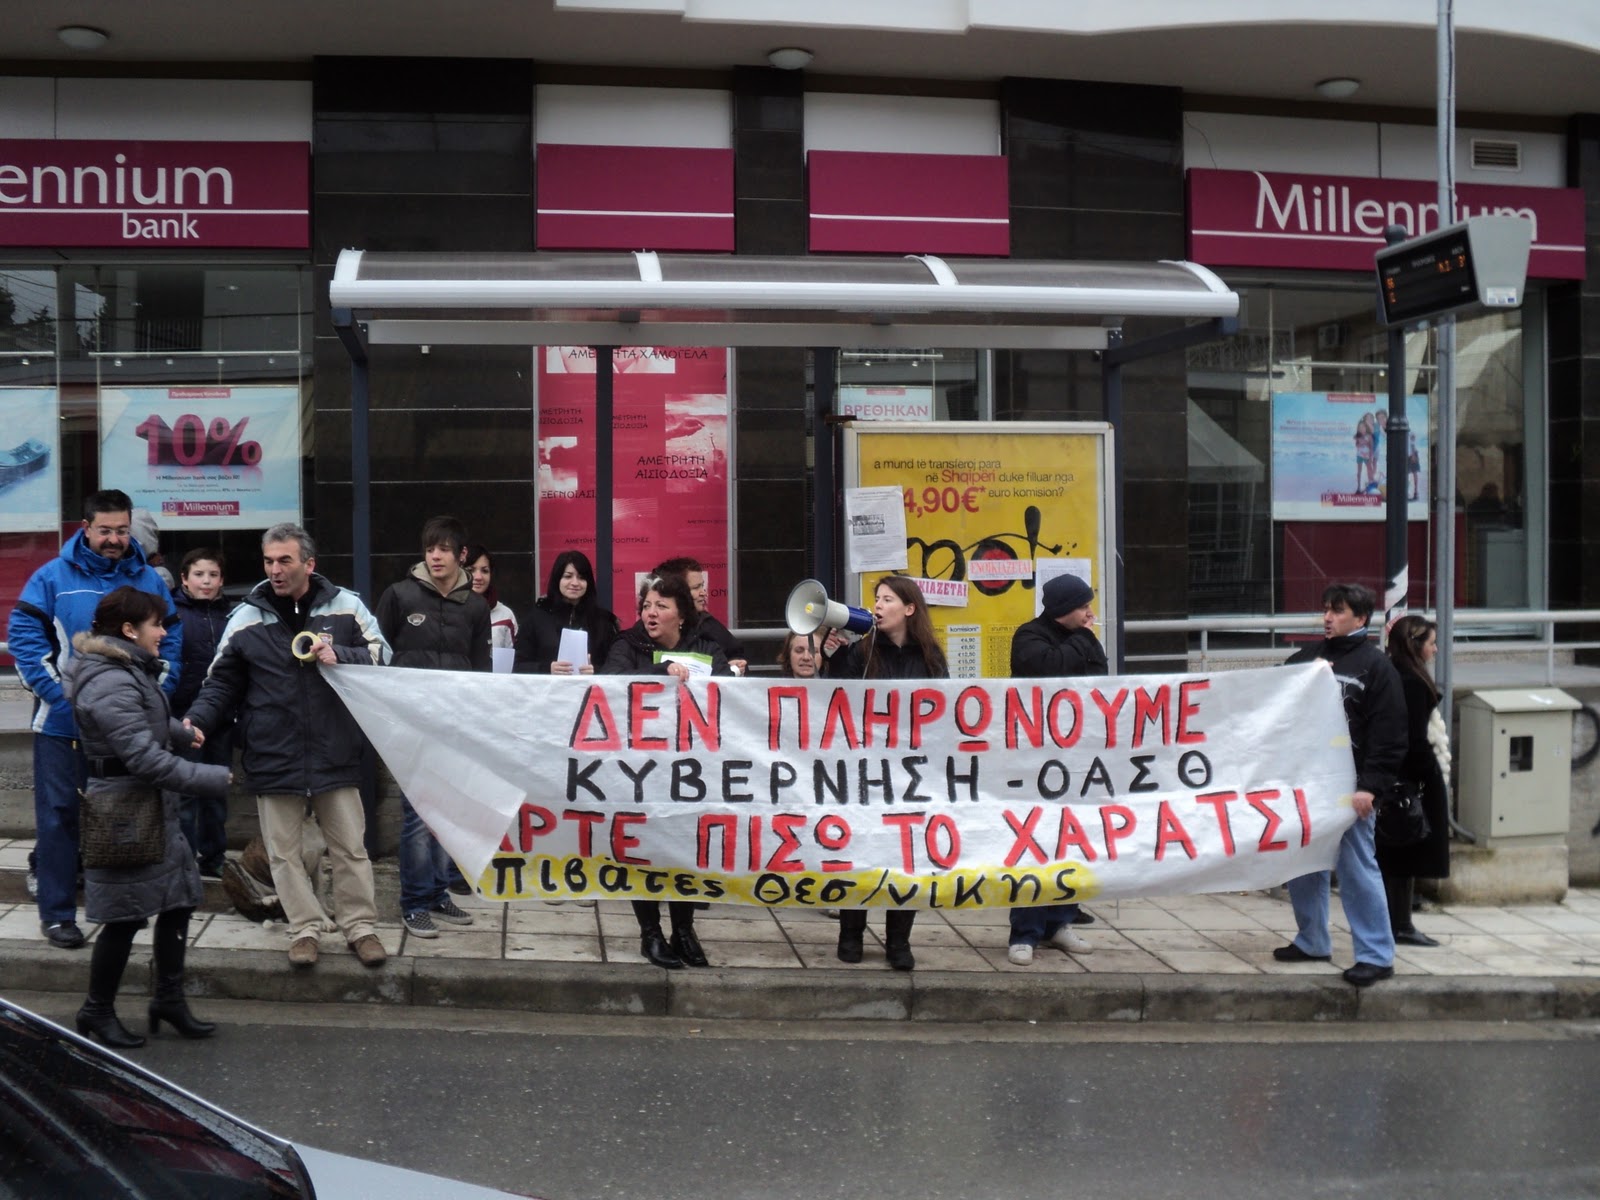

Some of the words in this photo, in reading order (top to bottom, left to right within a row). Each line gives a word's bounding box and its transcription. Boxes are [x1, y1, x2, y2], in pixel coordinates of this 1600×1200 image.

[122, 211, 200, 239] bank
[569, 348, 636, 360] ΑΜΕΗΤΑ
[844, 404, 929, 417] ΒΡΕΘΗΚΑΝ
[135, 414, 263, 467] 10%
[637, 455, 706, 466] ΑΜΕΤΡΗΤΗ
[873, 460, 881, 469] a
[883, 458, 914, 469] mund
[916, 459, 927, 469] të
[929, 458, 977, 471] transferoj
[978, 460, 1001, 471] para
[635, 468, 708, 479] ΑΙΣΙΟΔΟΞΙΑ
[925, 472, 939, 483] në
[941, 469, 996, 485] Shqipëri
[998, 472, 1025, 482] duke
[1027, 472, 1053, 482] filluar
[1054, 474, 1074, 484] nga
[541, 489, 597, 500] ΞΕΓΝΟΙΑΣΙ
[988, 489, 1011, 498] euro
[1013, 487, 1065, 498] komision?
[1337, 494, 1378, 503] Millennium
[183, 502, 234, 512] Millennium
[915, 580, 967, 597] ΚΙΑΖΕΤΑΙ
[569, 681, 722, 752] ΔΕΝ
[767, 679, 1210, 752] ΠΛΗΡΩΝΟΥΜΕ
[566, 754, 979, 805] ΚΥΒΕΡΝΗΣΗ
[499, 802, 651, 865] ΡΤΕ
[696, 813, 853, 873] ΠΙΣΩ
[881, 811, 961, 875] ΤΟ
[1002, 788, 1312, 868] ΧΑΡΑΤΣΙ
[477, 856, 725, 899] πιβάτες
